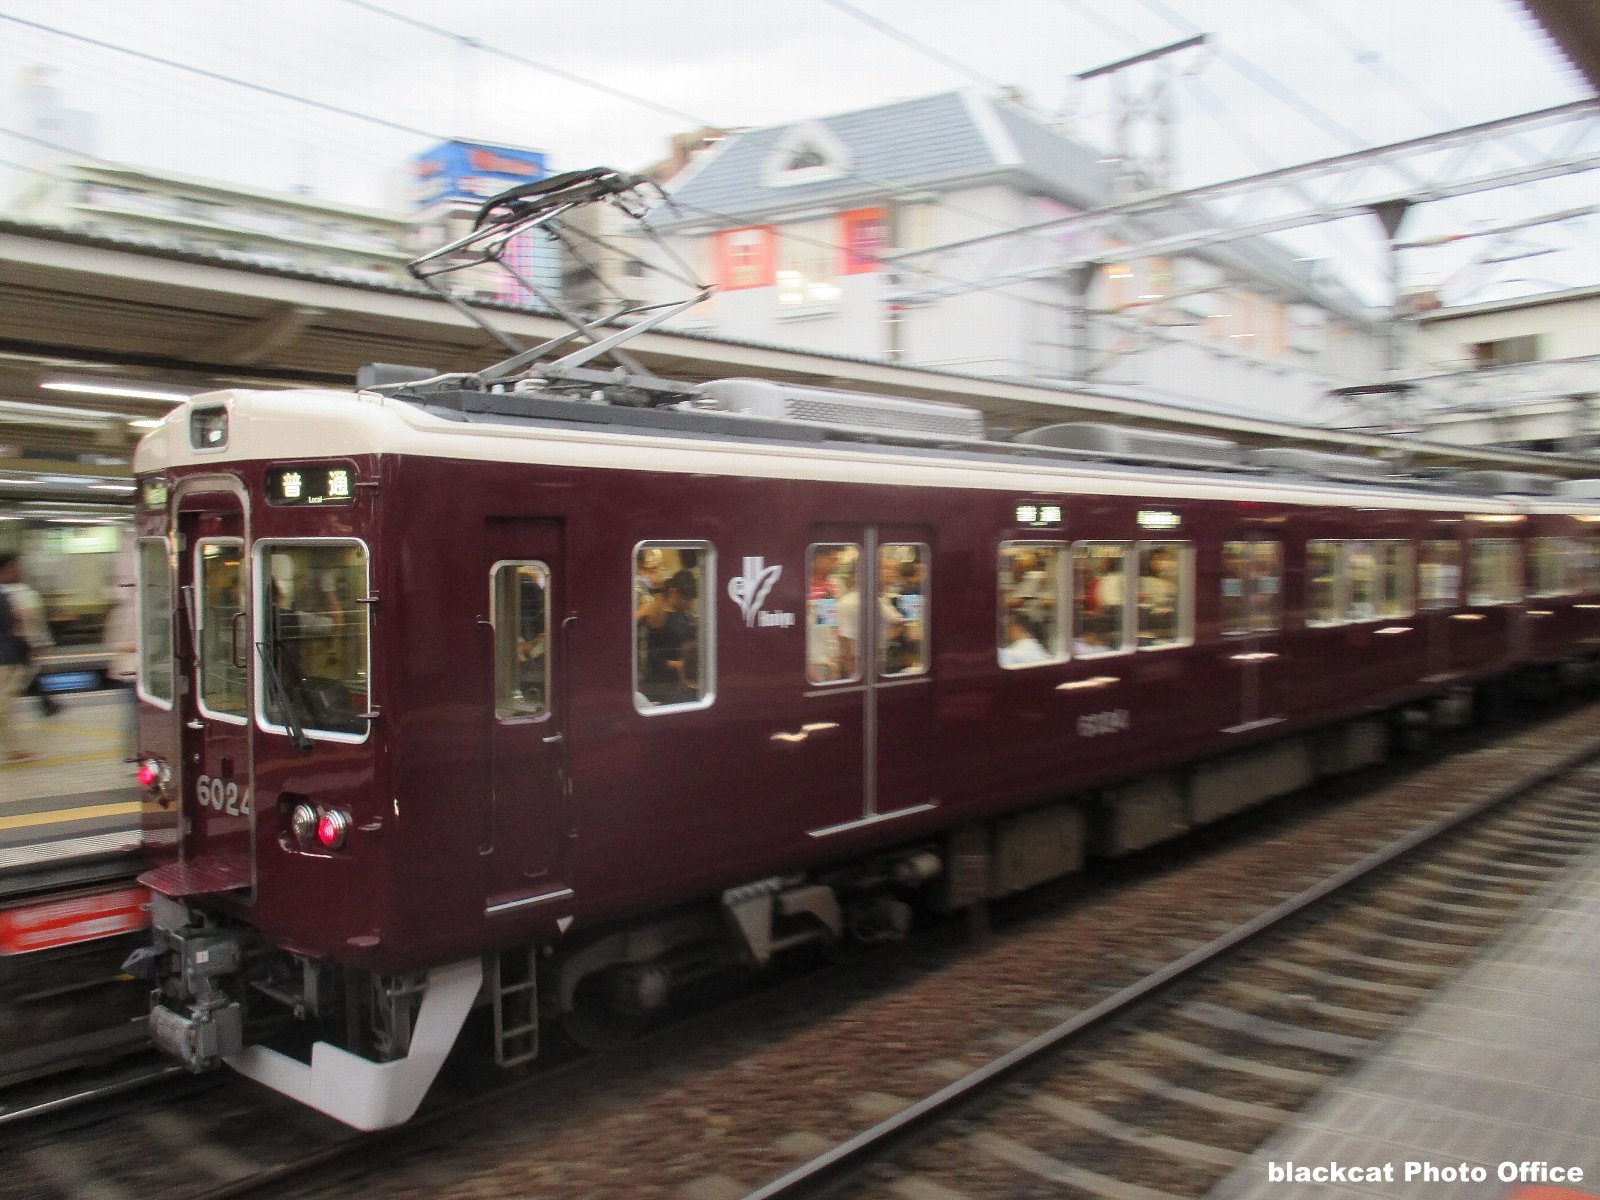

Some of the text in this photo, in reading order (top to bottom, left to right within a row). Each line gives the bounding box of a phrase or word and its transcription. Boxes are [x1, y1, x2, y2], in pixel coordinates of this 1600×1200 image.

[282, 470, 348, 498] 普通
[308, 495, 323, 504] Local
[196, 774, 250, 817] 6024
